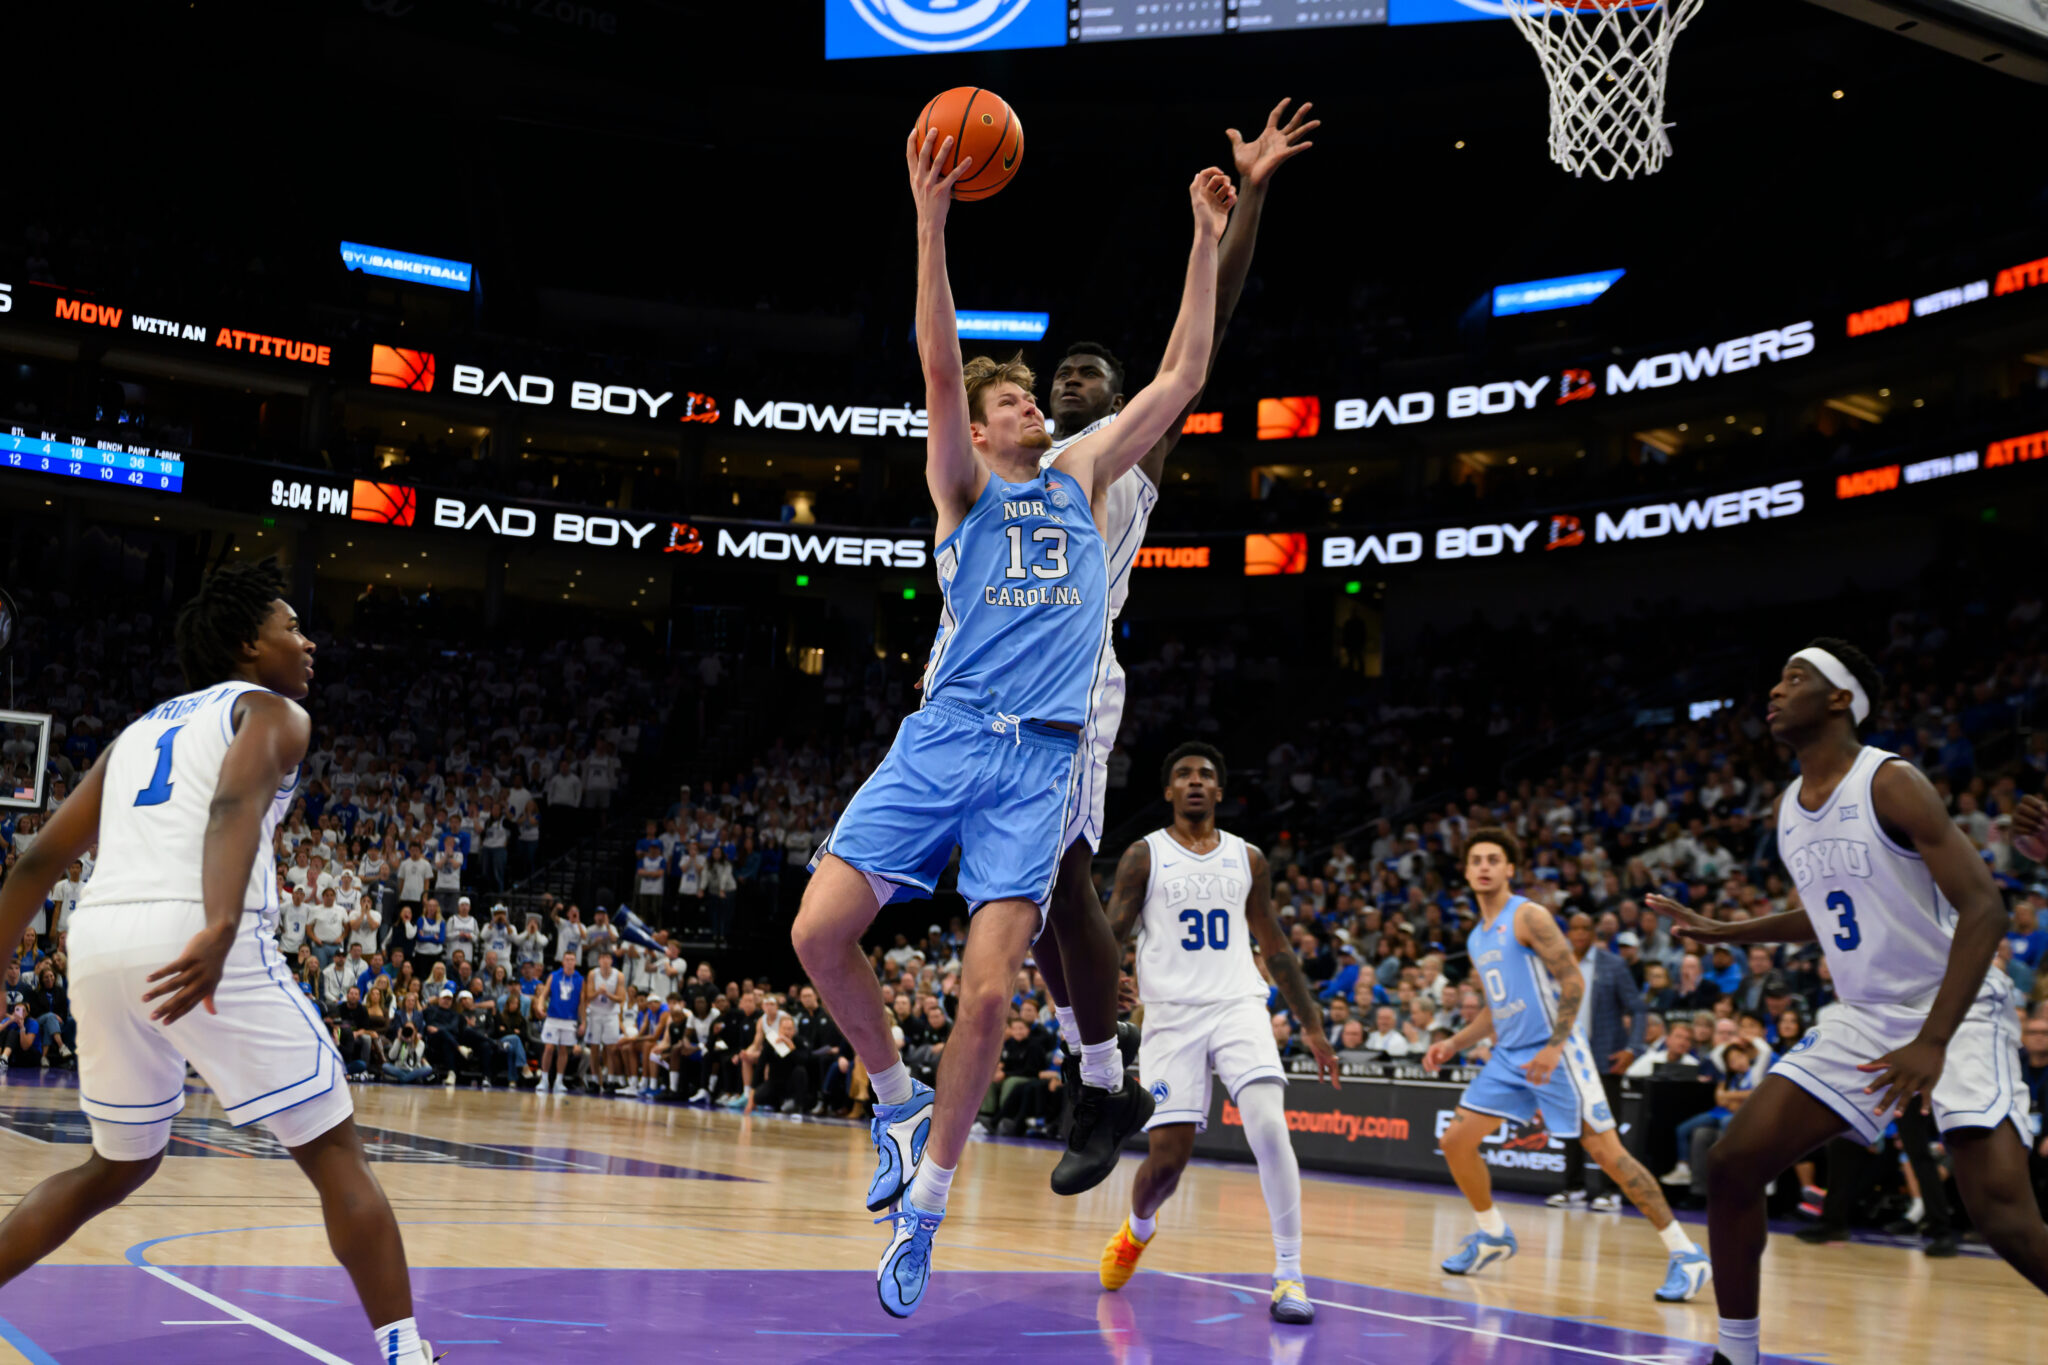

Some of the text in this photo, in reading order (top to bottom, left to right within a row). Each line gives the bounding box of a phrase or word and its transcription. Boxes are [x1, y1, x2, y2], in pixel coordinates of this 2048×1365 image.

[55, 297, 331, 366] MOW WITH AN ATTITUDE
[453, 364, 928, 437] BAD BOY MOWERS
[1334, 320, 1815, 430] BAD BOY MOWERS
[8, 454, 21, 466] 12
[41, 458, 50, 470] 3
[69, 463, 82, 475] 12
[100, 468, 113, 480] 10
[128, 472, 144, 484] 42
[13, 438, 21, 449] 7
[42, 443, 50, 455] 4
[102, 453, 115, 465] 10
[41, 431, 56, 442] BLK
[71, 436, 86, 446] TOV
[97, 440, 123, 453] BENCH
[128, 445, 150, 457] PAINT
[271, 479, 349, 515] 9:04 PM
[434, 497, 927, 568] BAD BOY MOWERS
[1322, 480, 1804, 568] BAD BOY MOWERS
[1005, 526, 1069, 579] 13
[133, 723, 188, 807] 1
[1163, 873, 1242, 909] BYU
[1790, 838, 1872, 892] BYU
[1179, 908, 1229, 951] 30
[1825, 889, 1863, 952] 3
[1485, 968, 1507, 1002] 0
[1487, 1150, 1566, 1172] MOWERS
